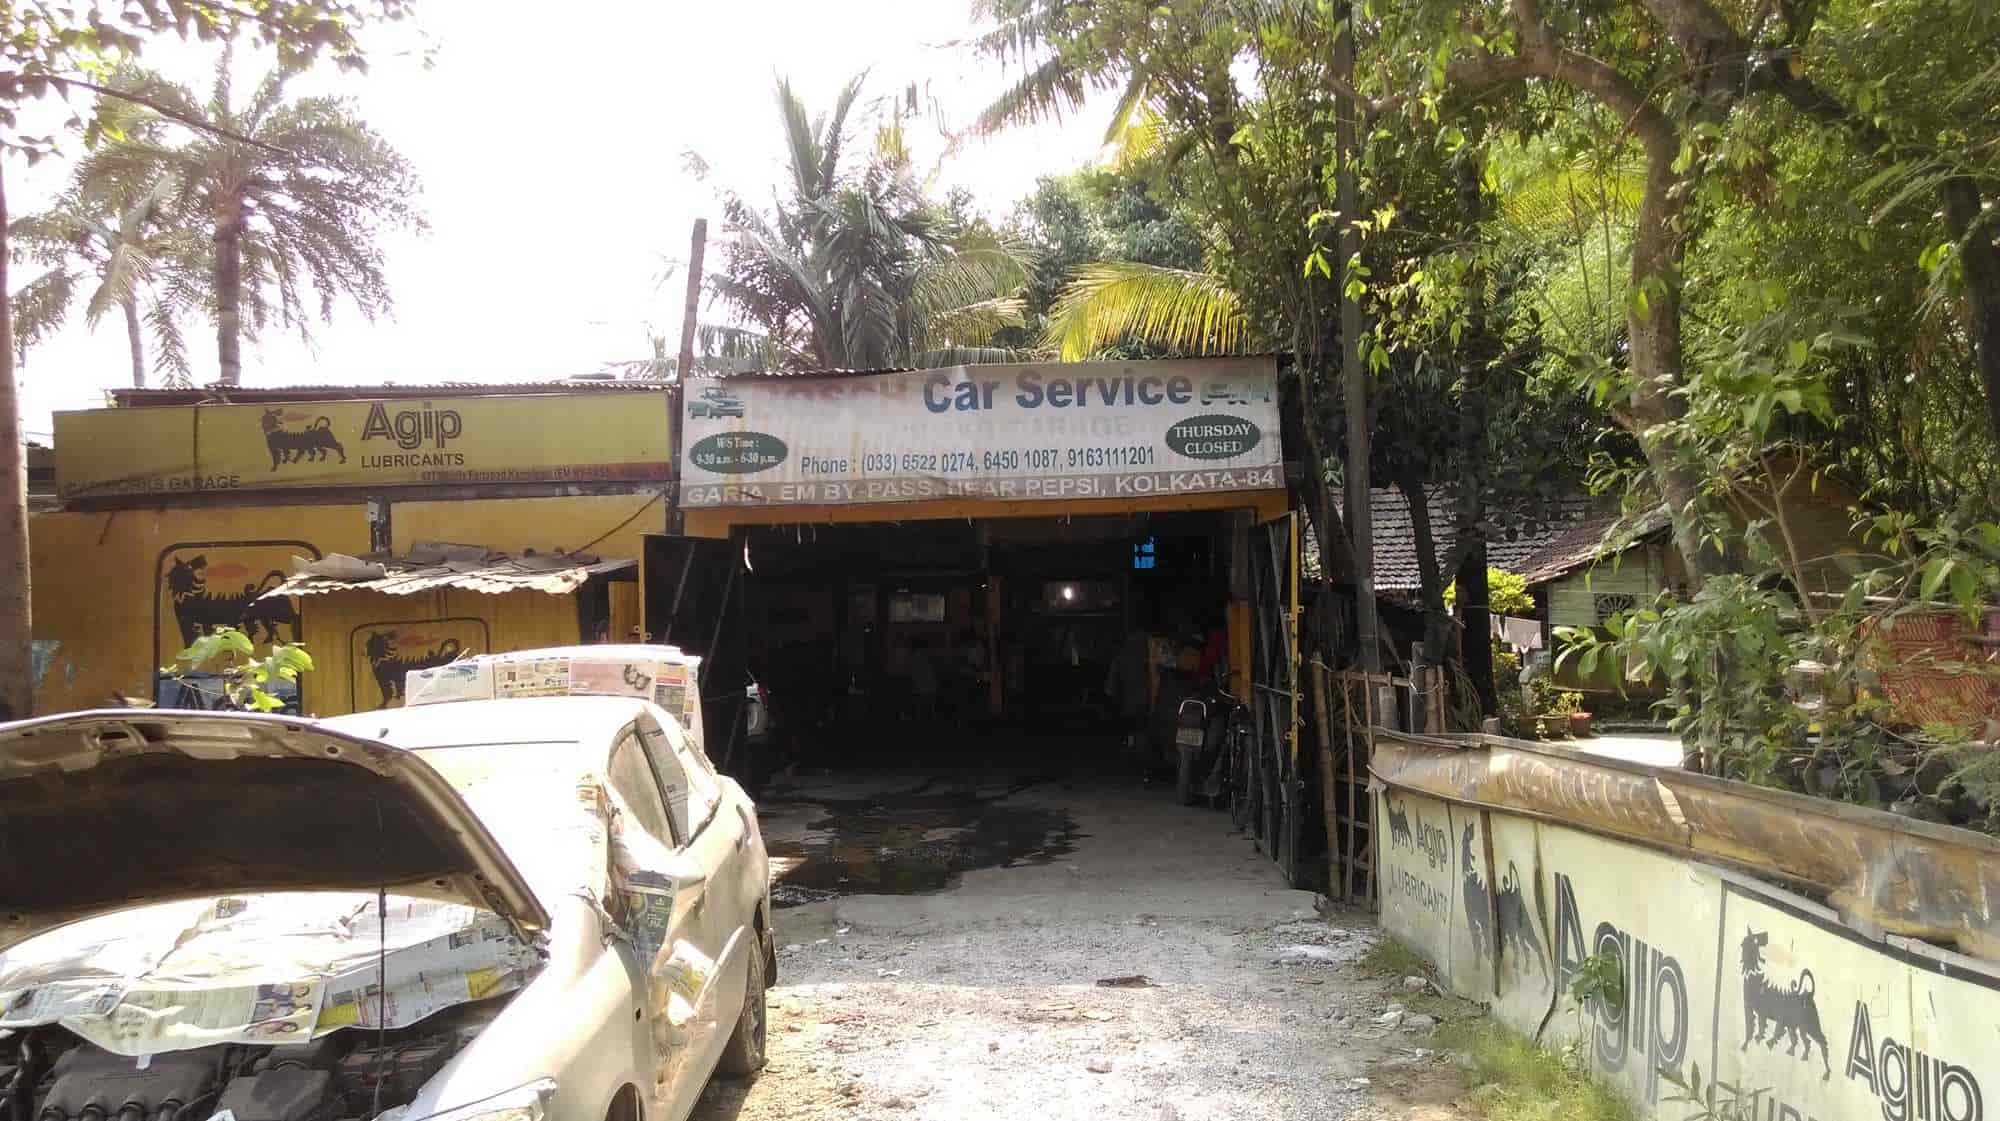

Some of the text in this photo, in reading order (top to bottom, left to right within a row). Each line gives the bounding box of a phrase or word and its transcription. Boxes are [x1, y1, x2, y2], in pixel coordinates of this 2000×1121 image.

[922, 374, 1000, 413] Car
[1015, 370, 1193, 409] Service
[361, 400, 462, 450] Agip
[1174, 423, 1251, 438] THURSDAY
[361, 453, 465, 468] LUBRICANTS
[801, 456, 847, 474] Phone
[862, 452, 897, 474] (033)
[902, 452, 937, 471] 6522
[983, 450, 1018, 470] 6450
[1068, 446, 1155, 467] 9163111201
[1184, 440, 1242, 455] CLOSED
[782, 483, 816, 501] EM
[1116, 469, 1275, 493] KOLKATA-84
[1416, 808, 1448, 872] Agip
[1391, 864, 1449, 924] LUBRICANTS
[1554, 872, 1688, 1105] Agip
[1845, 1000, 1984, 1121] Agip
